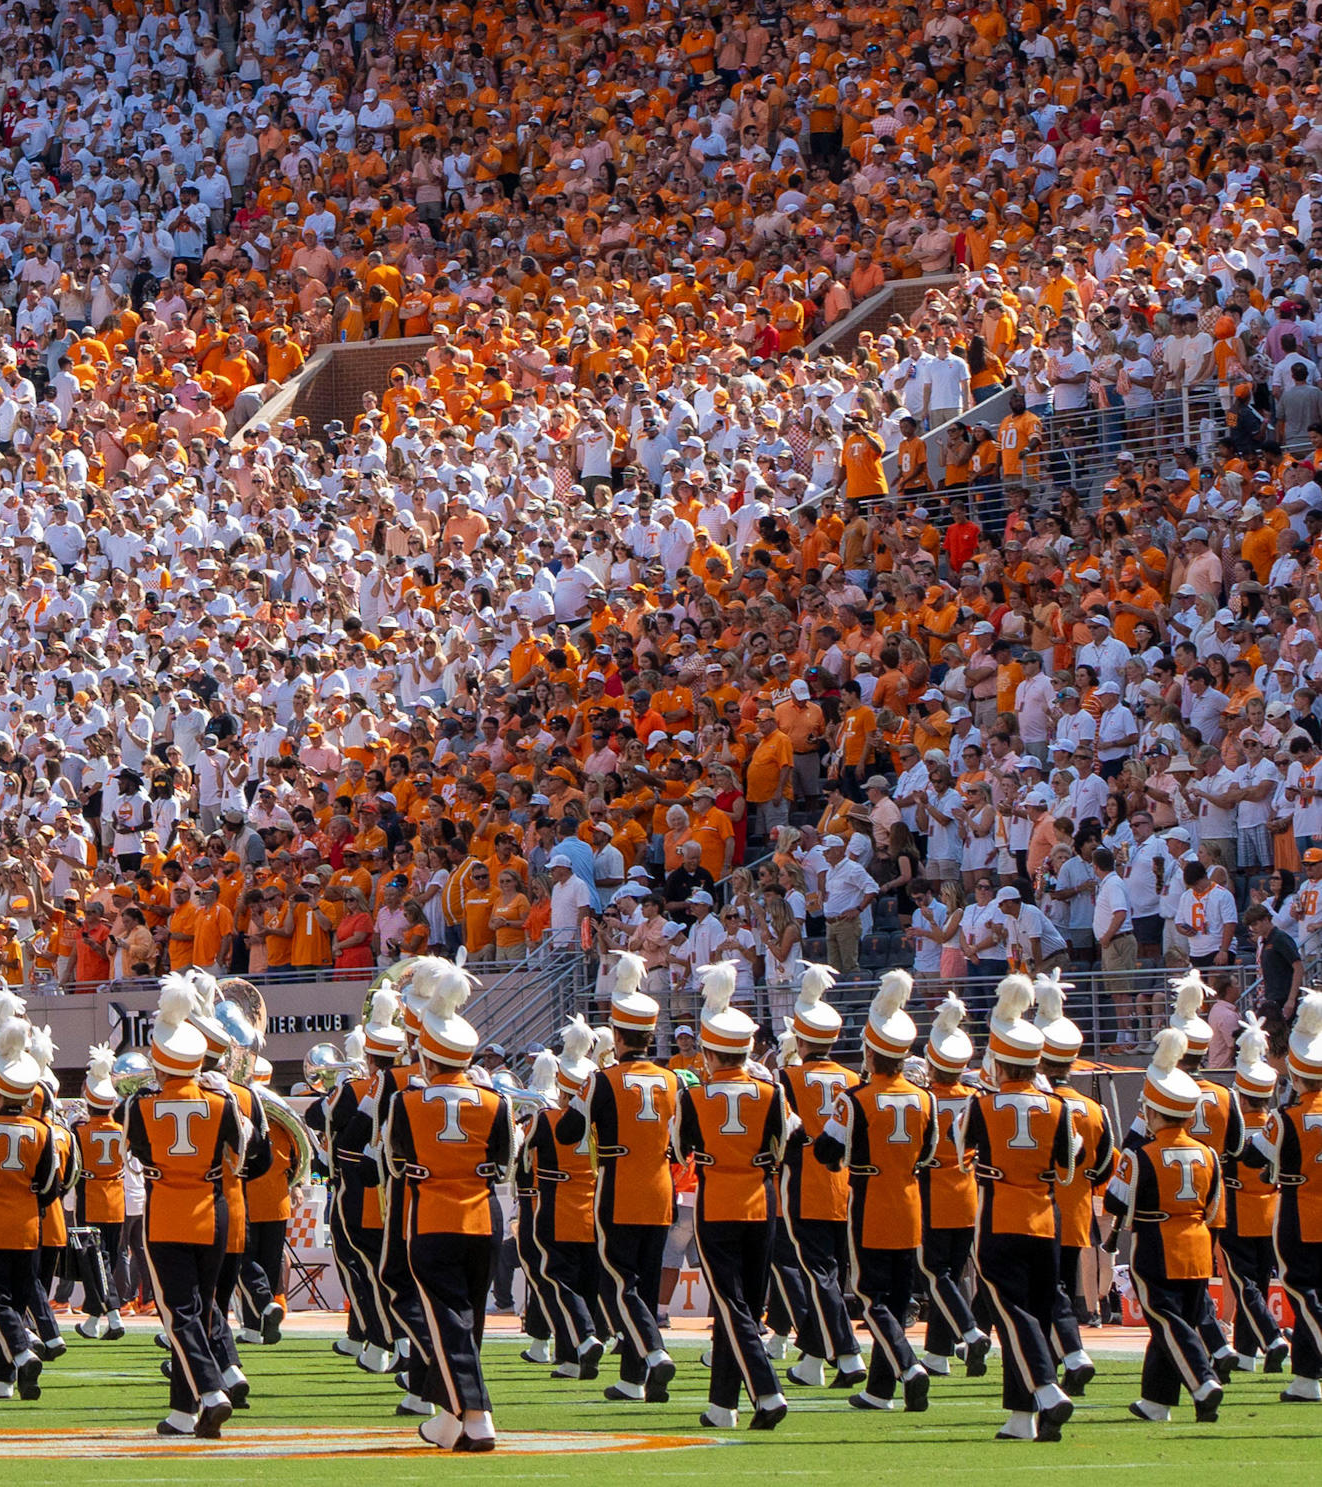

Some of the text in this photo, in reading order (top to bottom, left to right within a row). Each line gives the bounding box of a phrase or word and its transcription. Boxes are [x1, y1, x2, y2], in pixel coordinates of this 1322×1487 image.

[814, 450, 825, 462] T
[851, 442, 863, 456] T
[901, 453, 910, 472] 8
[972, 455, 981, 472] 8
[647, 531, 658, 544] T
[846, 716, 857, 732] T
[306, 911, 313, 936] 1
[1192, 903, 1205, 931] 6
[305, 1013, 344, 1033] CLUB
[622, 1073, 668, 1121] T
[704, 1081, 759, 1135] T
[804, 1071, 848, 1116] T
[153, 1100, 210, 1155] T
[423, 1085, 482, 1143] T
[875, 1093, 922, 1144] T
[994, 1094, 1050, 1150] T
[1191, 1091, 1219, 1136] T
[89, 1131, 122, 1165] T
[1161, 1147, 1207, 1202] T
[680, 1271, 699, 1311] T
